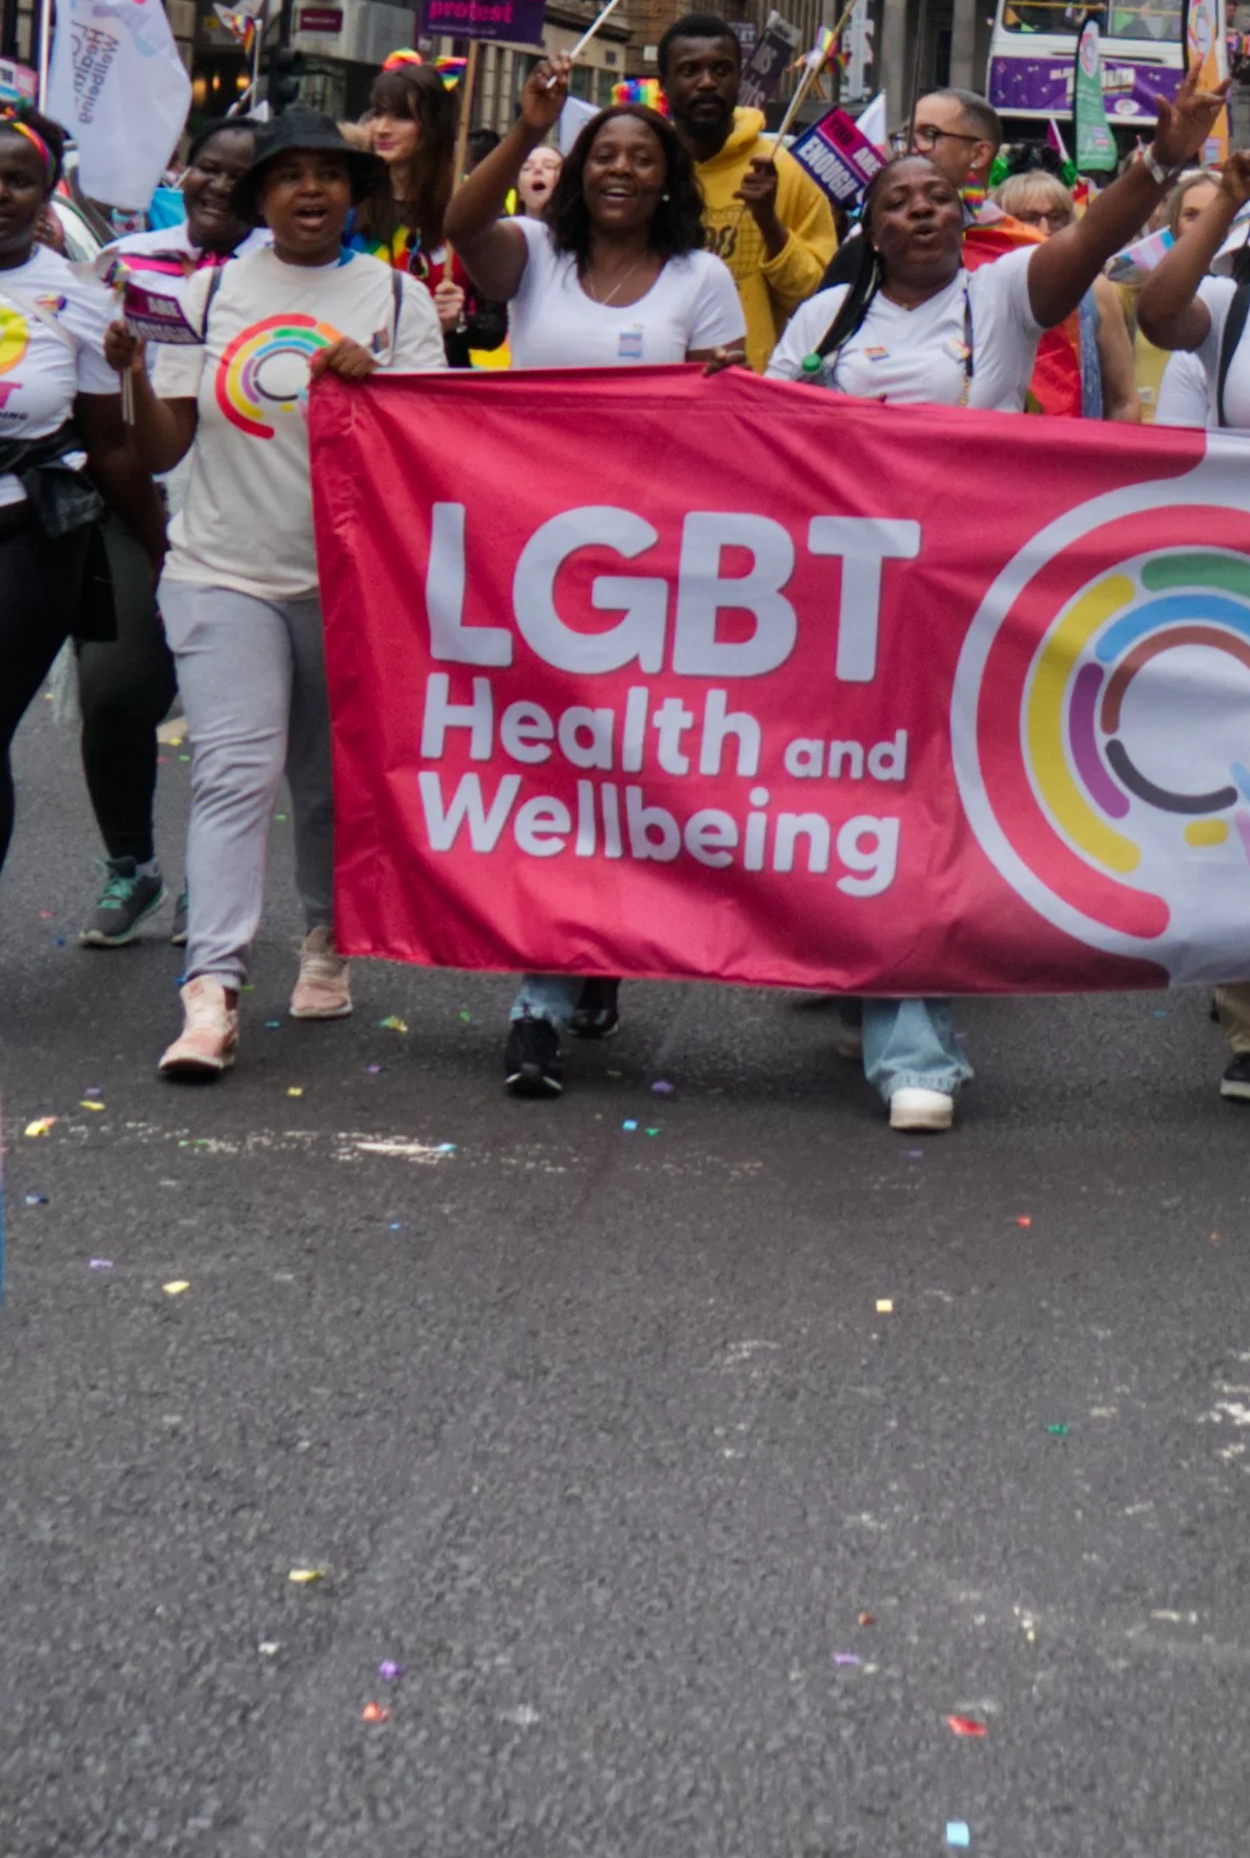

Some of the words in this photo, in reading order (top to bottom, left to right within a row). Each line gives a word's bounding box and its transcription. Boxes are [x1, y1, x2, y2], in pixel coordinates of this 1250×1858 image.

[429, 0, 514, 24] protest
[797, 135, 859, 199] ENOUGH
[852, 146, 882, 177] ARE
[425, 502, 921, 682] LGBT
[418, 672, 762, 776] Health
[784, 729, 908, 781] and
[417, 771, 901, 897] Wellbeing
